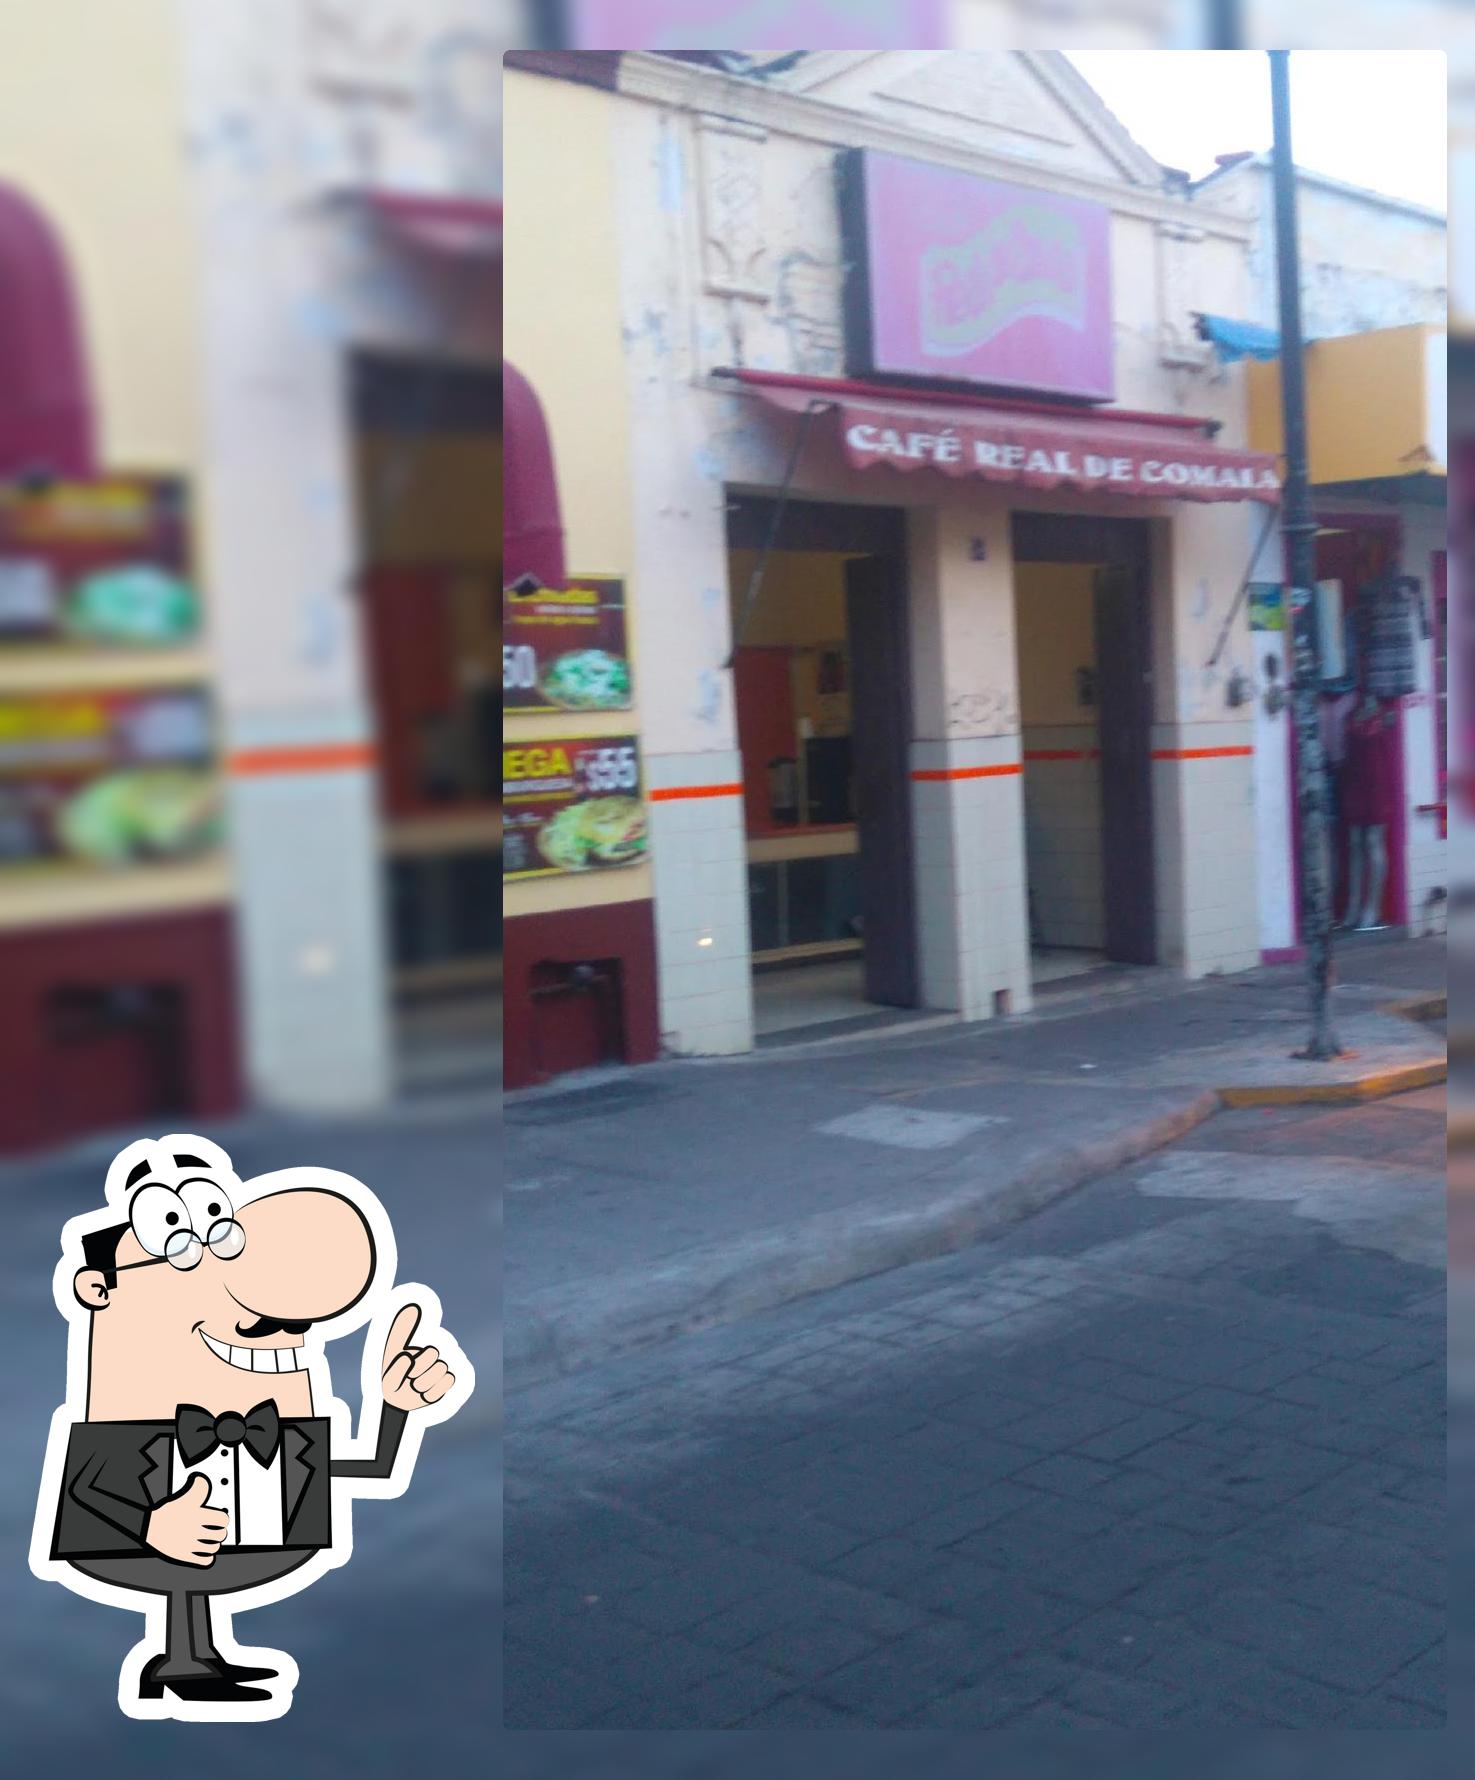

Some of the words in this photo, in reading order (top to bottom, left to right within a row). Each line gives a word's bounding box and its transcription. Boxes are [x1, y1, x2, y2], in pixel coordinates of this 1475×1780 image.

[847, 424, 962, 462] CAFÉ
[973, 440, 1077, 476] REAL
[1083, 454, 1134, 481] DE
[1140, 460, 1281, 488] COMALA
[503, 747, 572, 779] EGA
